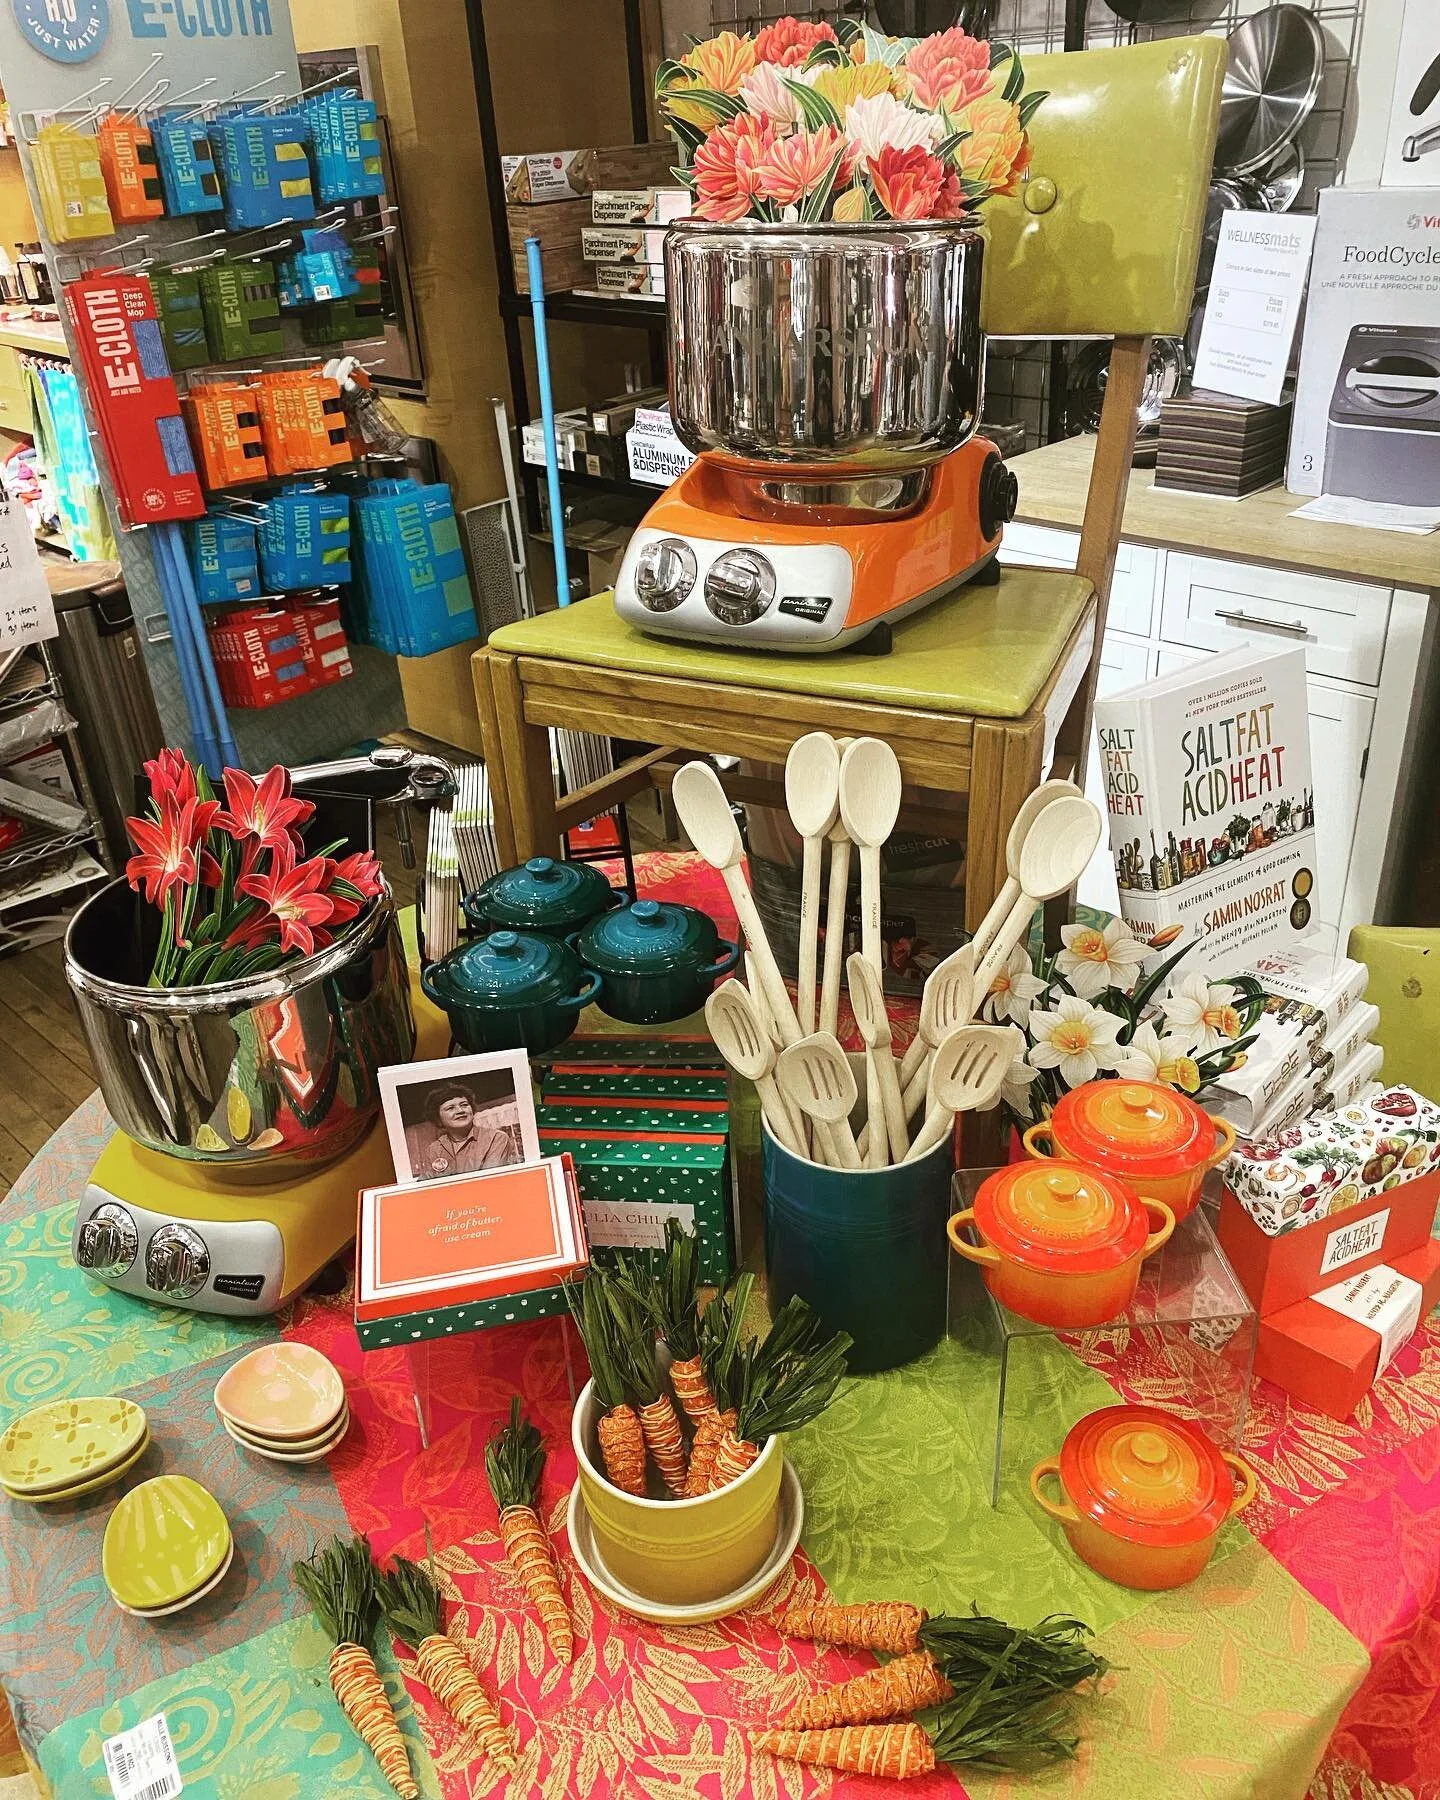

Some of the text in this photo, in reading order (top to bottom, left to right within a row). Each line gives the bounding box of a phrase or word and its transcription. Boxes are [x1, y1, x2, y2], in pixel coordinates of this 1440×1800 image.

[28, 17, 100, 52] JUST WATER
[342, 106, 360, 162] E-CLOTH
[113, 131, 138, 185] E-CLOTH
[168, 129, 196, 182] E-CLOTH
[246, 127, 269, 187] E-CLOTH
[593, 201, 629, 211] Parchment
[593, 210, 626, 220] Dispenser
[584, 239, 638, 250] Parchment Paper
[585, 248, 616, 257] Dispenser
[597, 268, 626, 278] Parchment
[599, 276, 624, 286] Dispenser
[218, 270, 242, 325] E-CLOTH
[127, 309, 144, 318] Mop
[83, 289, 140, 389] E-CLOTH
[304, 386, 325, 434] E-CLOTH
[217, 399, 240, 448] E-CLOTH
[633, 447, 686, 466] ALUMINUM
[1302, 454, 1313, 472] 3
[294, 505, 312, 556] E-CLOTH
[199, 523, 219, 571] E-CLOTH
[395, 503, 436, 590] E-CLOTH
[243, 628, 270, 679] E-CLOTH
[1188, 697, 1202, 706] OVER
[1207, 688, 1229, 699] MILLION
[1230, 681, 1249, 692] COPIES
[1249, 676, 1263, 685] SOLD
[1192, 708, 1204, 716] NEW
[1206, 702, 1219, 712] YORK
[1220, 696, 1236, 706] TIMES
[1237, 686, 1267, 701] BESTSELLER
[1100, 728, 1135, 750] SALT
[1106, 751, 1132, 772] FAT
[1108, 772, 1139, 794] ACID
[1107, 794, 1144, 816] HEAT
[1178, 889, 1213, 912] MASTERING
[1214, 884, 1225, 893] THE
[1227, 870, 1254, 889] ELEMENTS
[1262, 860, 1276, 874] GOOD
[1276, 850, 1301, 866] COOKING
[1203, 899, 1243, 936] SAMIN
[1243, 880, 1286, 916] NOSRAT
[1221, 927, 1242, 941] WENDY
[986, 944, 1004, 968] FRANCE
[1260, 976, 1309, 993] MASTERING
[446, 1205, 487, 1221] If you're
[1017, 1215, 1031, 1227] LE
[428, 1221, 458, 1236] afraid
[459, 1219, 471, 1230] of
[444, 1229, 490, 1243] use cream
